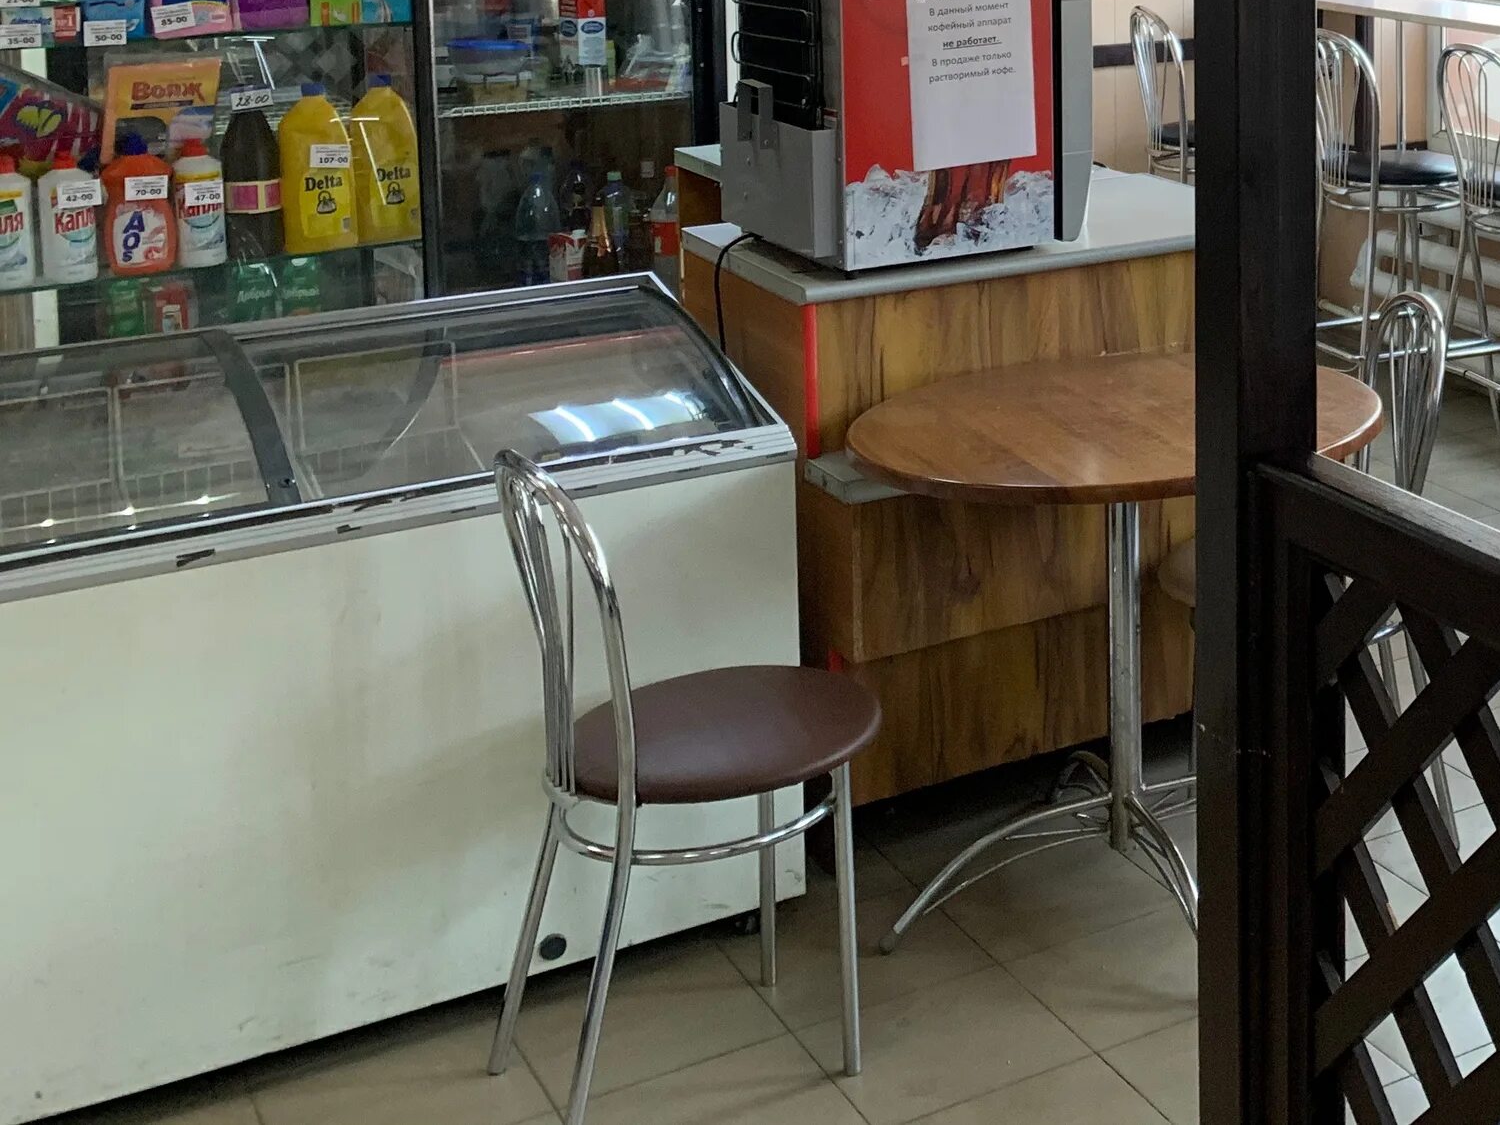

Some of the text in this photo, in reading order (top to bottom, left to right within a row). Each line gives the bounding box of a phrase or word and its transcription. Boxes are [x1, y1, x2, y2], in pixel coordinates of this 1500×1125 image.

[937, 5, 973, 17] данный
[975, 2, 1009, 12] момент
[161, 16, 188, 26] 85-00
[928, 17, 1012, 32] кофейный аппарат
[95, 33, 122, 42] 50-00
[943, 40, 954, 48] не
[940, 55, 980, 67] продаже
[982, 51, 1012, 61] только
[929, 68, 989, 84] растворимый
[131, 81, 205, 102] Вояж
[319, 156, 348, 164] 107-00
[377, 167, 411, 182] Delta
[305, 175, 343, 192] Delta
[66, 193, 93, 202] 42-00
[135, 188, 162, 196] 70-00
[194, 193, 220, 201] 47-00
[122, 211, 145, 262] AOS
